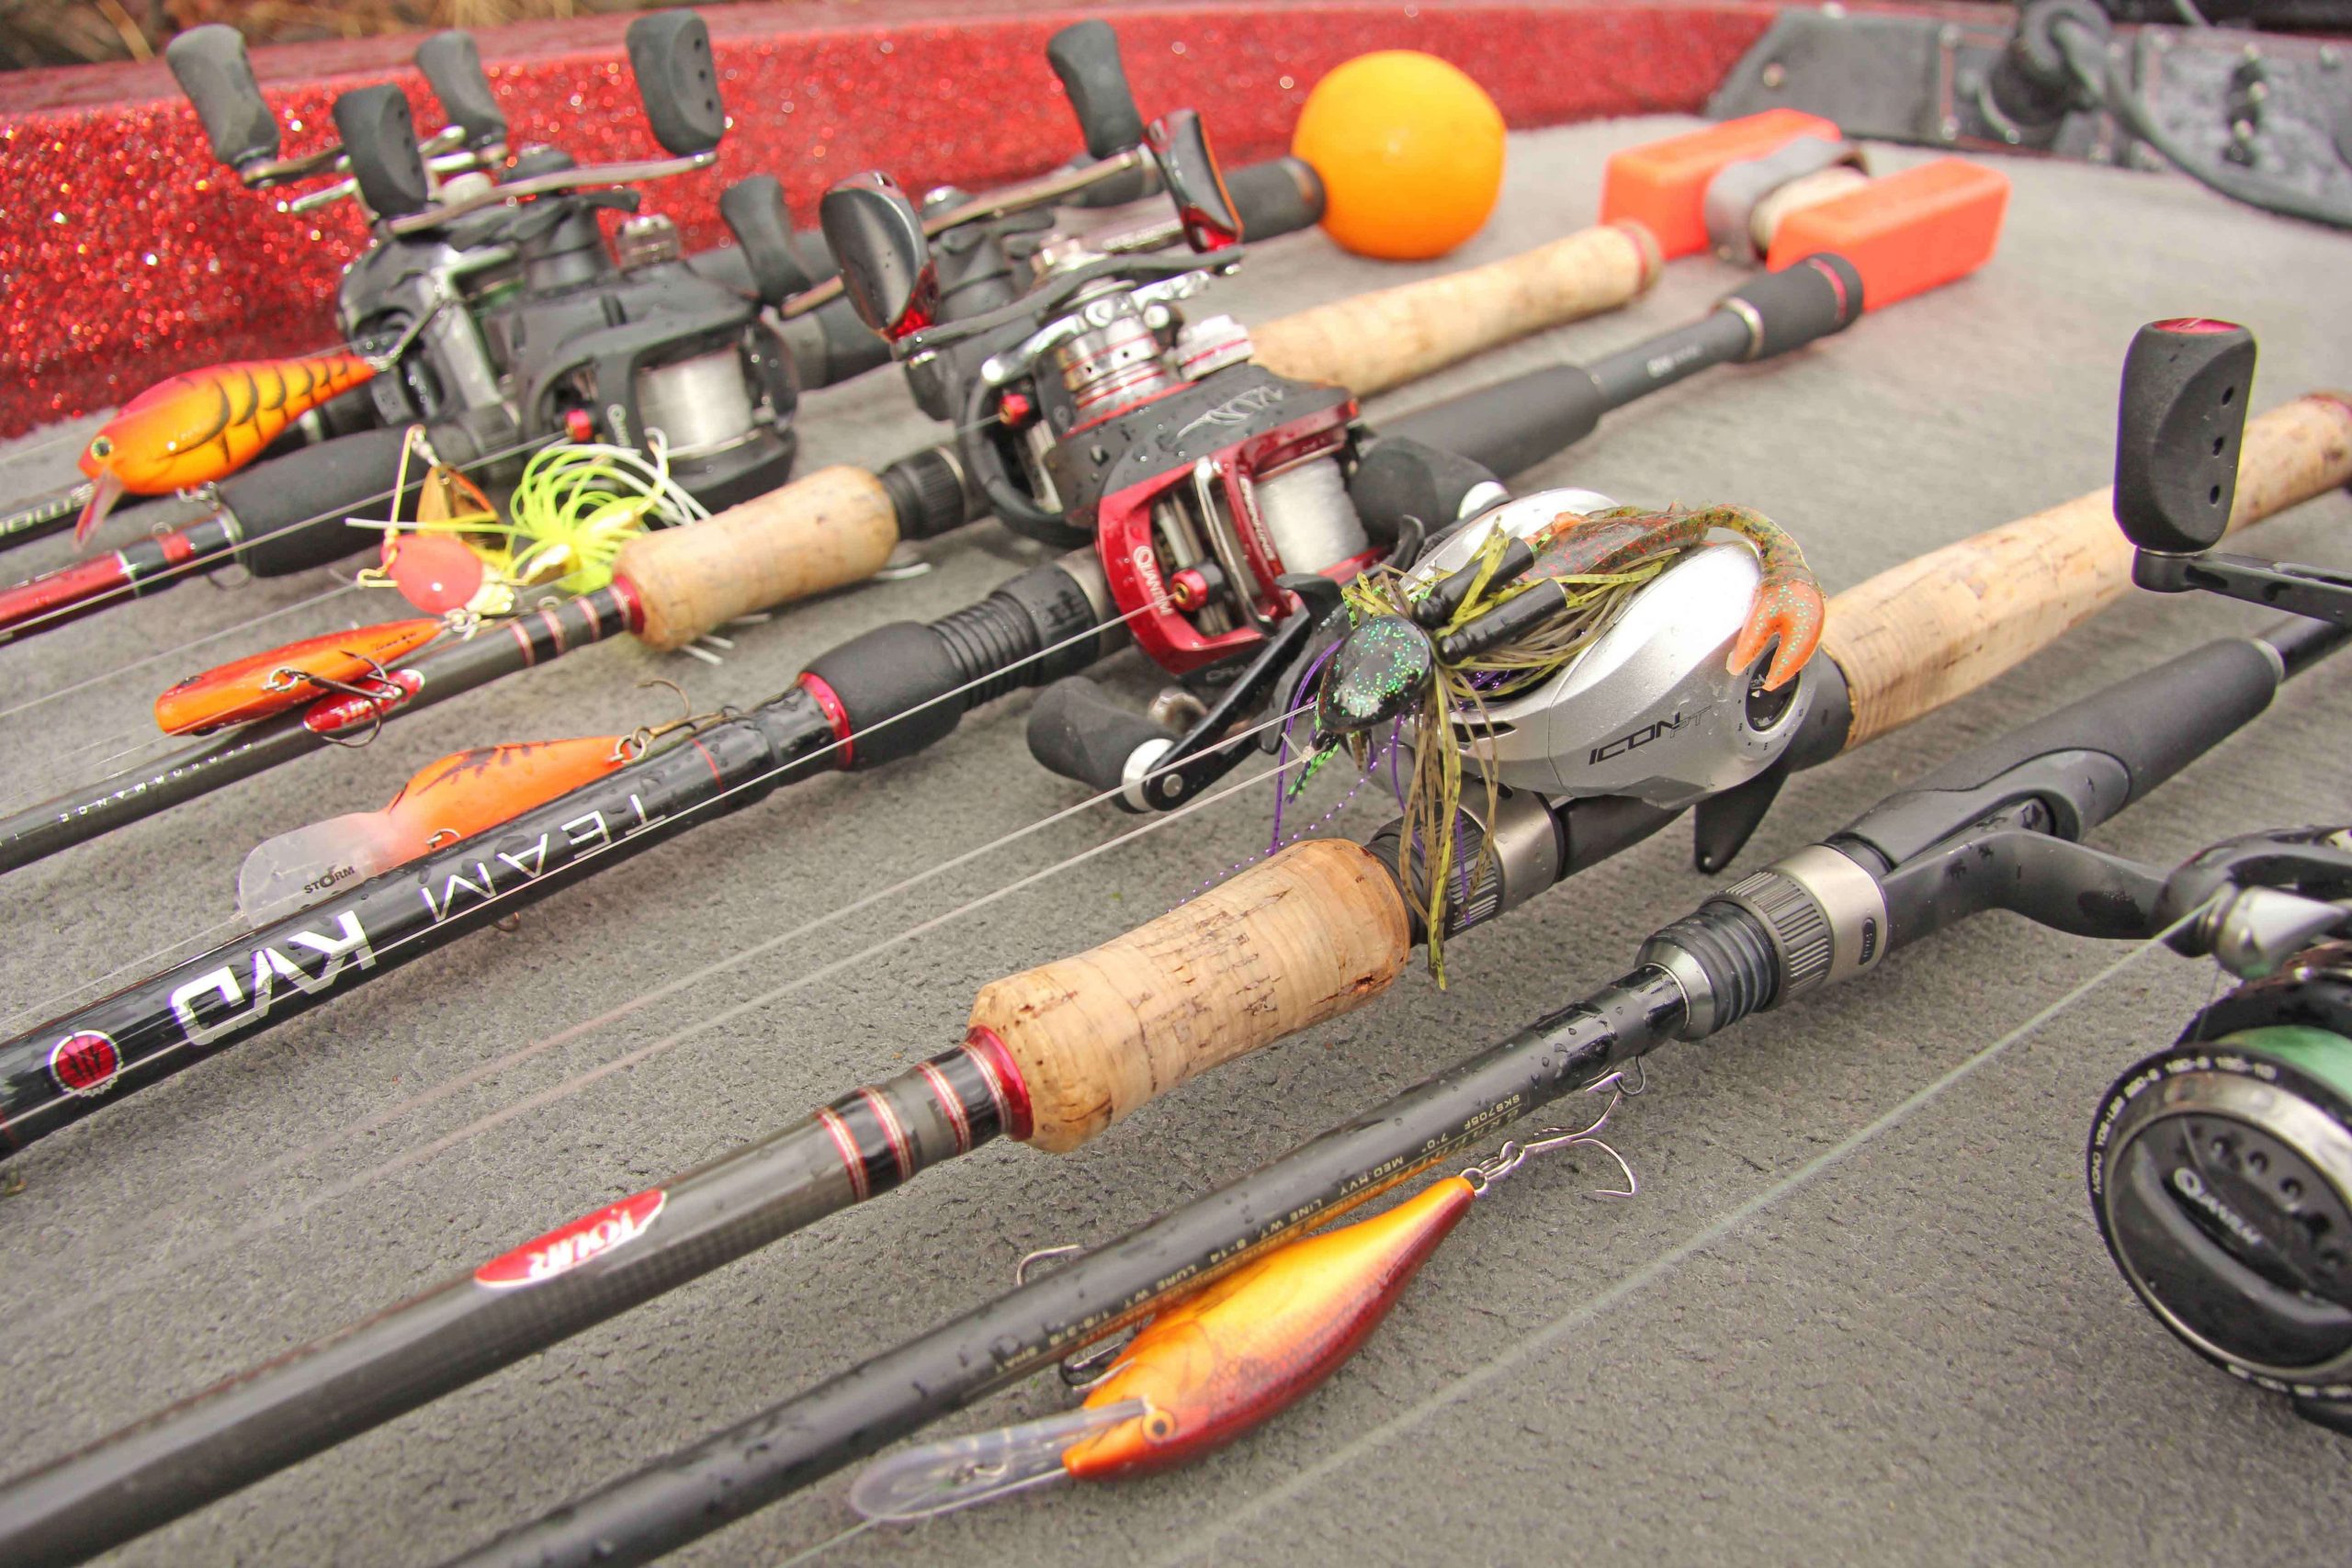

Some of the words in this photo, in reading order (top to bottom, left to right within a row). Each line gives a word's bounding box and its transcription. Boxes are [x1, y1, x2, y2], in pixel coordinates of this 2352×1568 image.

[1132, 545, 1176, 617] QUANTUM
[1589, 711, 1680, 765] ICON
[303, 863, 356, 894] STORM
[421, 794, 667, 923] TEAM
[168, 909, 378, 1046] KVD
[1464, 1094, 1521, 1131] SKS705F
[1289, 1198, 1323, 1221] LINE
[526, 1209, 645, 1280] TOUR
[1157, 1264, 1197, 1291] LURE
